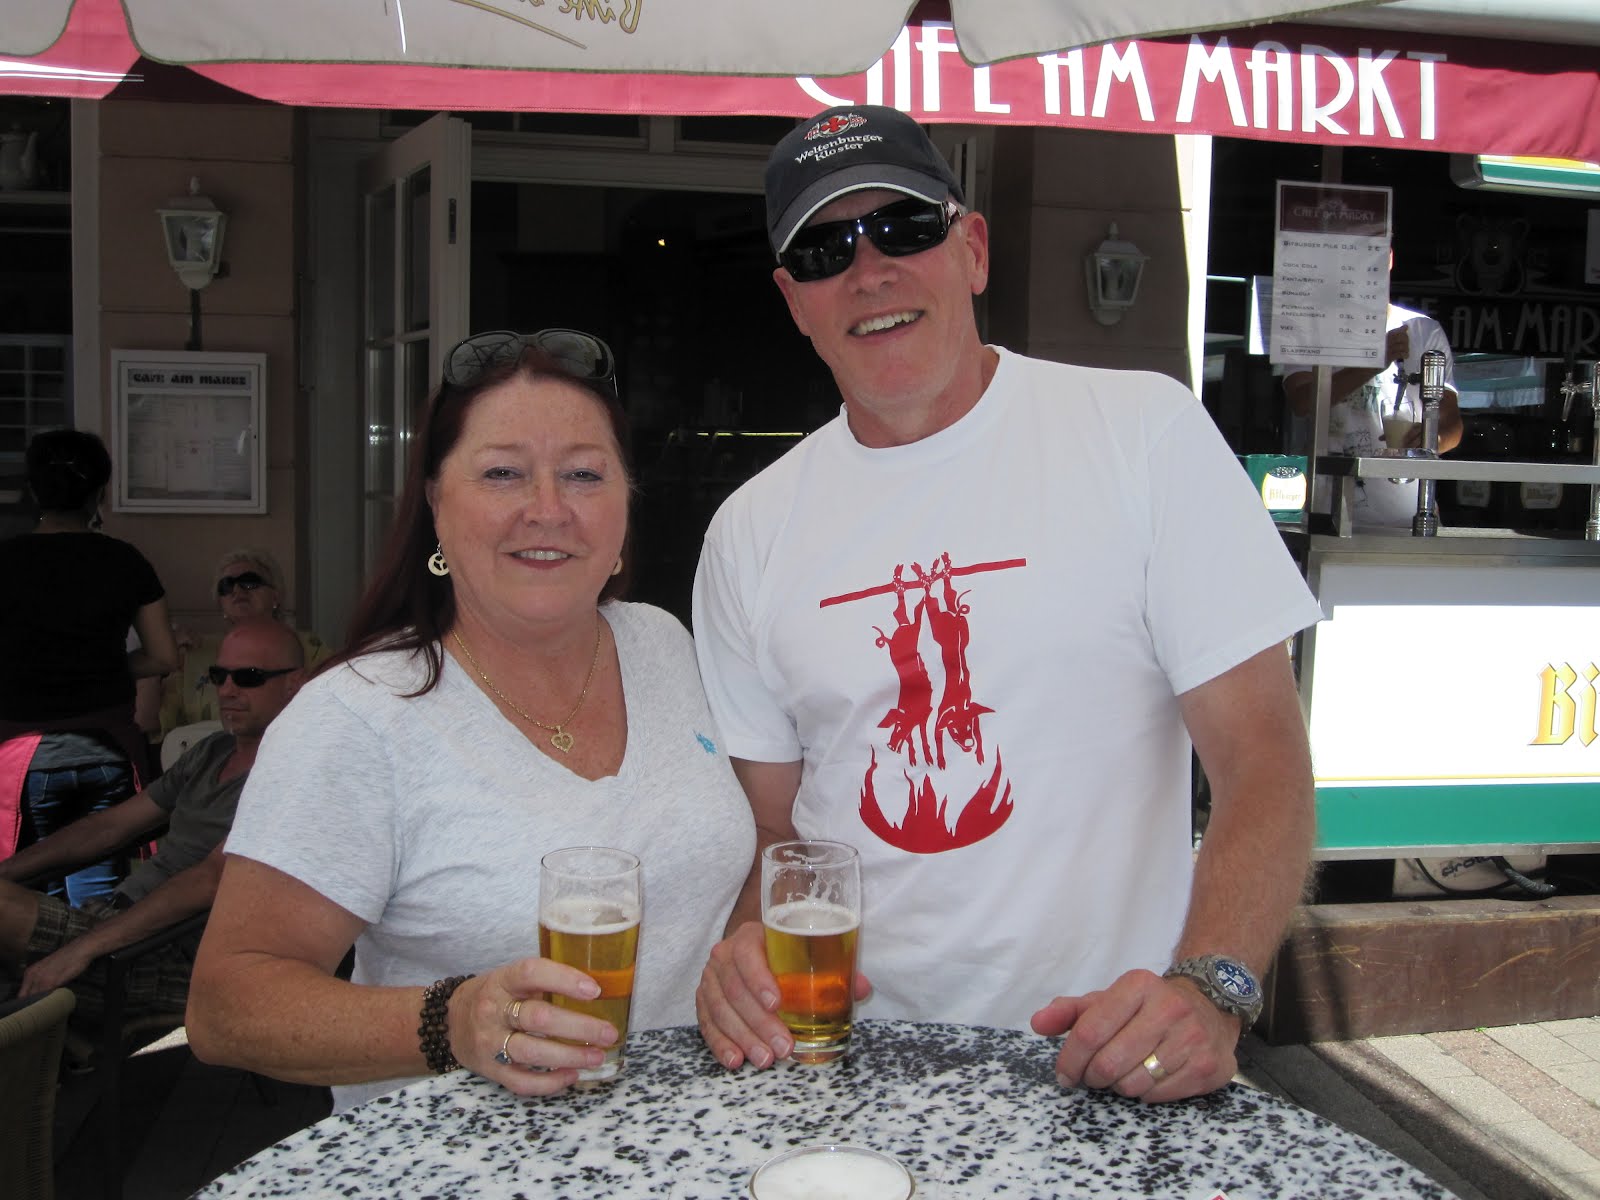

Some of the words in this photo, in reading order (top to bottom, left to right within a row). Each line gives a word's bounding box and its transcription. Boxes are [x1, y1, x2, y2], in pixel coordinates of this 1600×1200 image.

[1037, 41, 1154, 122] AM
[1175, 35, 1448, 140] MARKT
[794, 134, 883, 164] Weltenburger
[814, 142, 864, 162] Kloster
